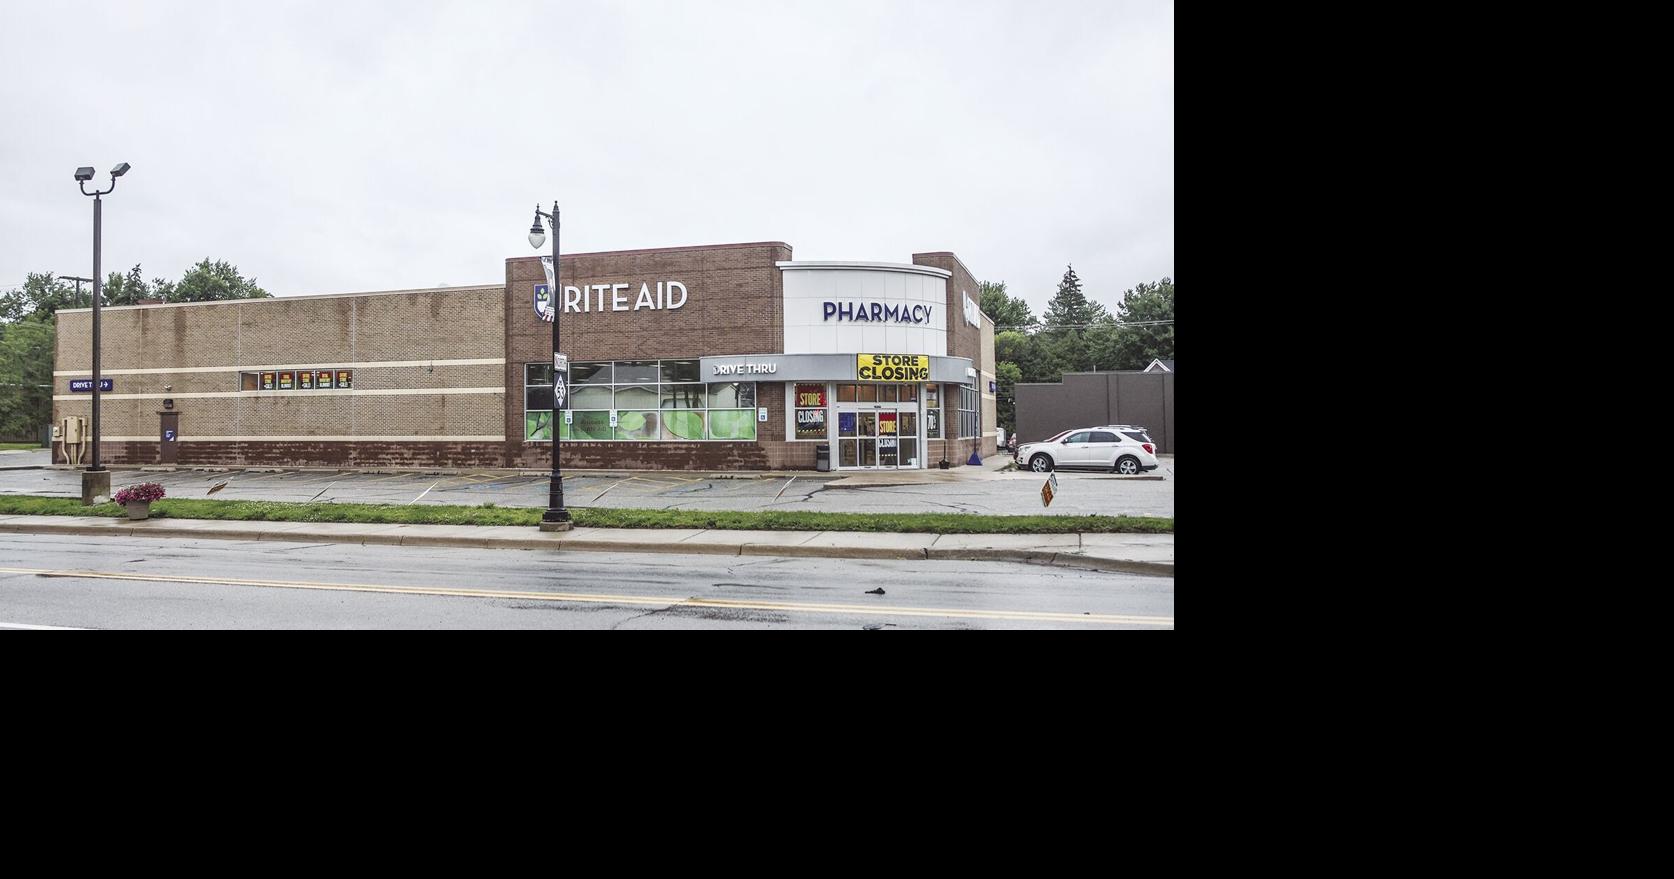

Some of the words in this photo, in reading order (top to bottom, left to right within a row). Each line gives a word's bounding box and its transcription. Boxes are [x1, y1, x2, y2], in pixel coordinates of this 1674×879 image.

[564, 283, 629, 313] RITE
[633, 281, 688, 311] AID
[823, 301, 932, 324] PHARMACY
[872, 355, 919, 366] STORE
[713, 364, 744, 375] DRIVE
[746, 362, 777, 374] THRU
[859, 366, 928, 380] CLOSING
[72, 381, 89, 389] DRIVE
[557, 386, 564, 400] 53
[800, 393, 821, 405] STORE
[798, 410, 824, 423] CLOSING
[879, 421, 896, 433] STORE
